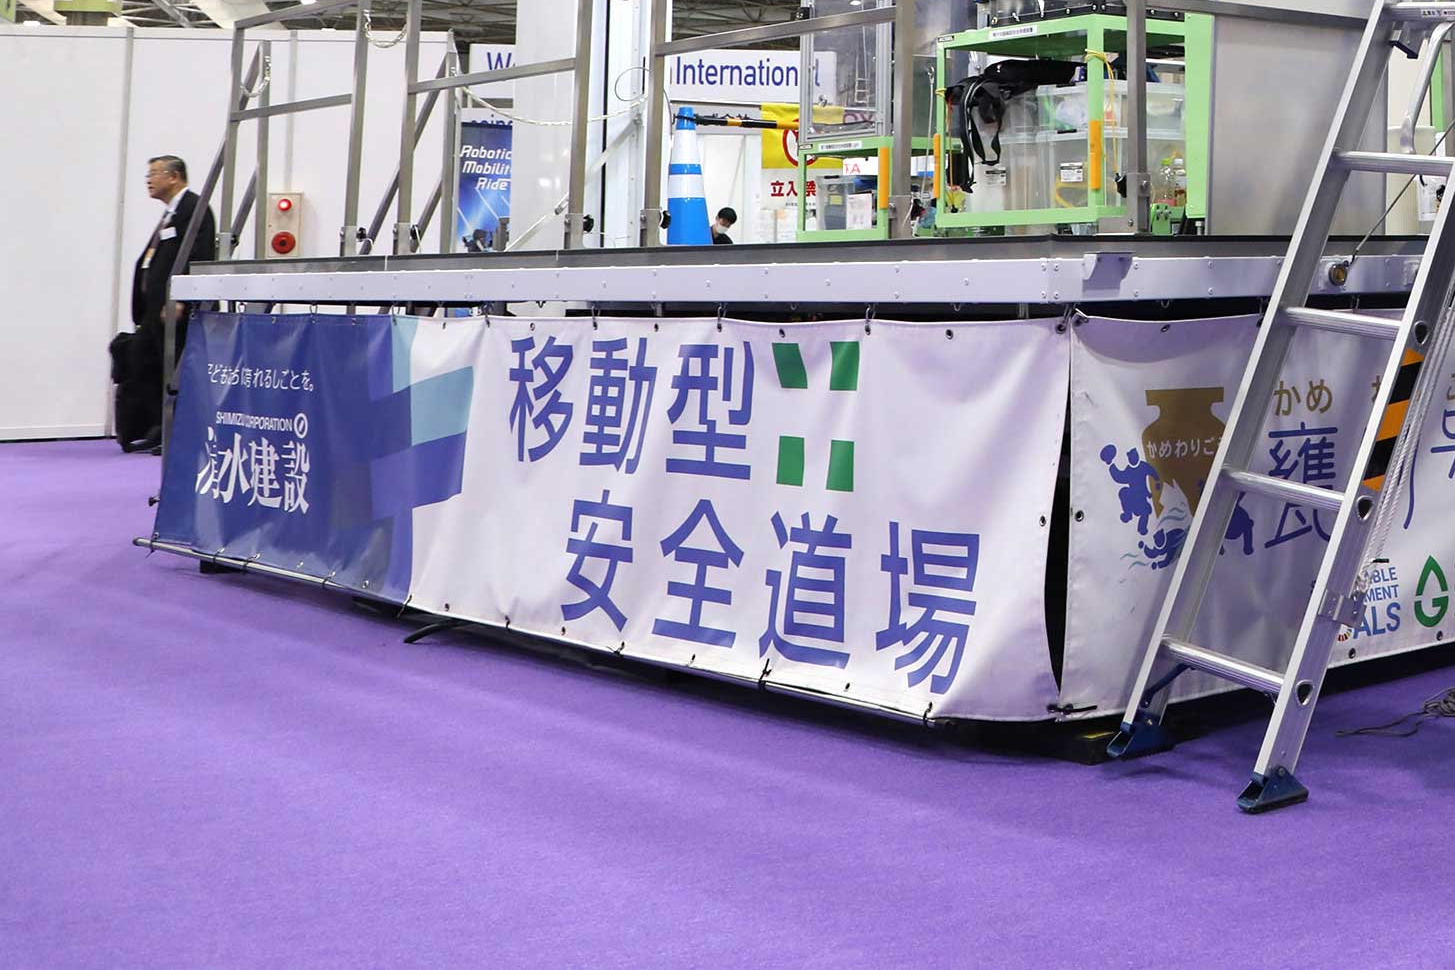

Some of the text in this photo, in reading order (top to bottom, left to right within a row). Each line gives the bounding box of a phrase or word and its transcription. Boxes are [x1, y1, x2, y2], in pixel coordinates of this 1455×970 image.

[676, 56, 820, 87] Internationl
[462, 161, 512, 175] Mobilit
[475, 177, 512, 190] Ride
[509, 336, 756, 481] 移動型
[560, 489, 980, 695] 安全道場
